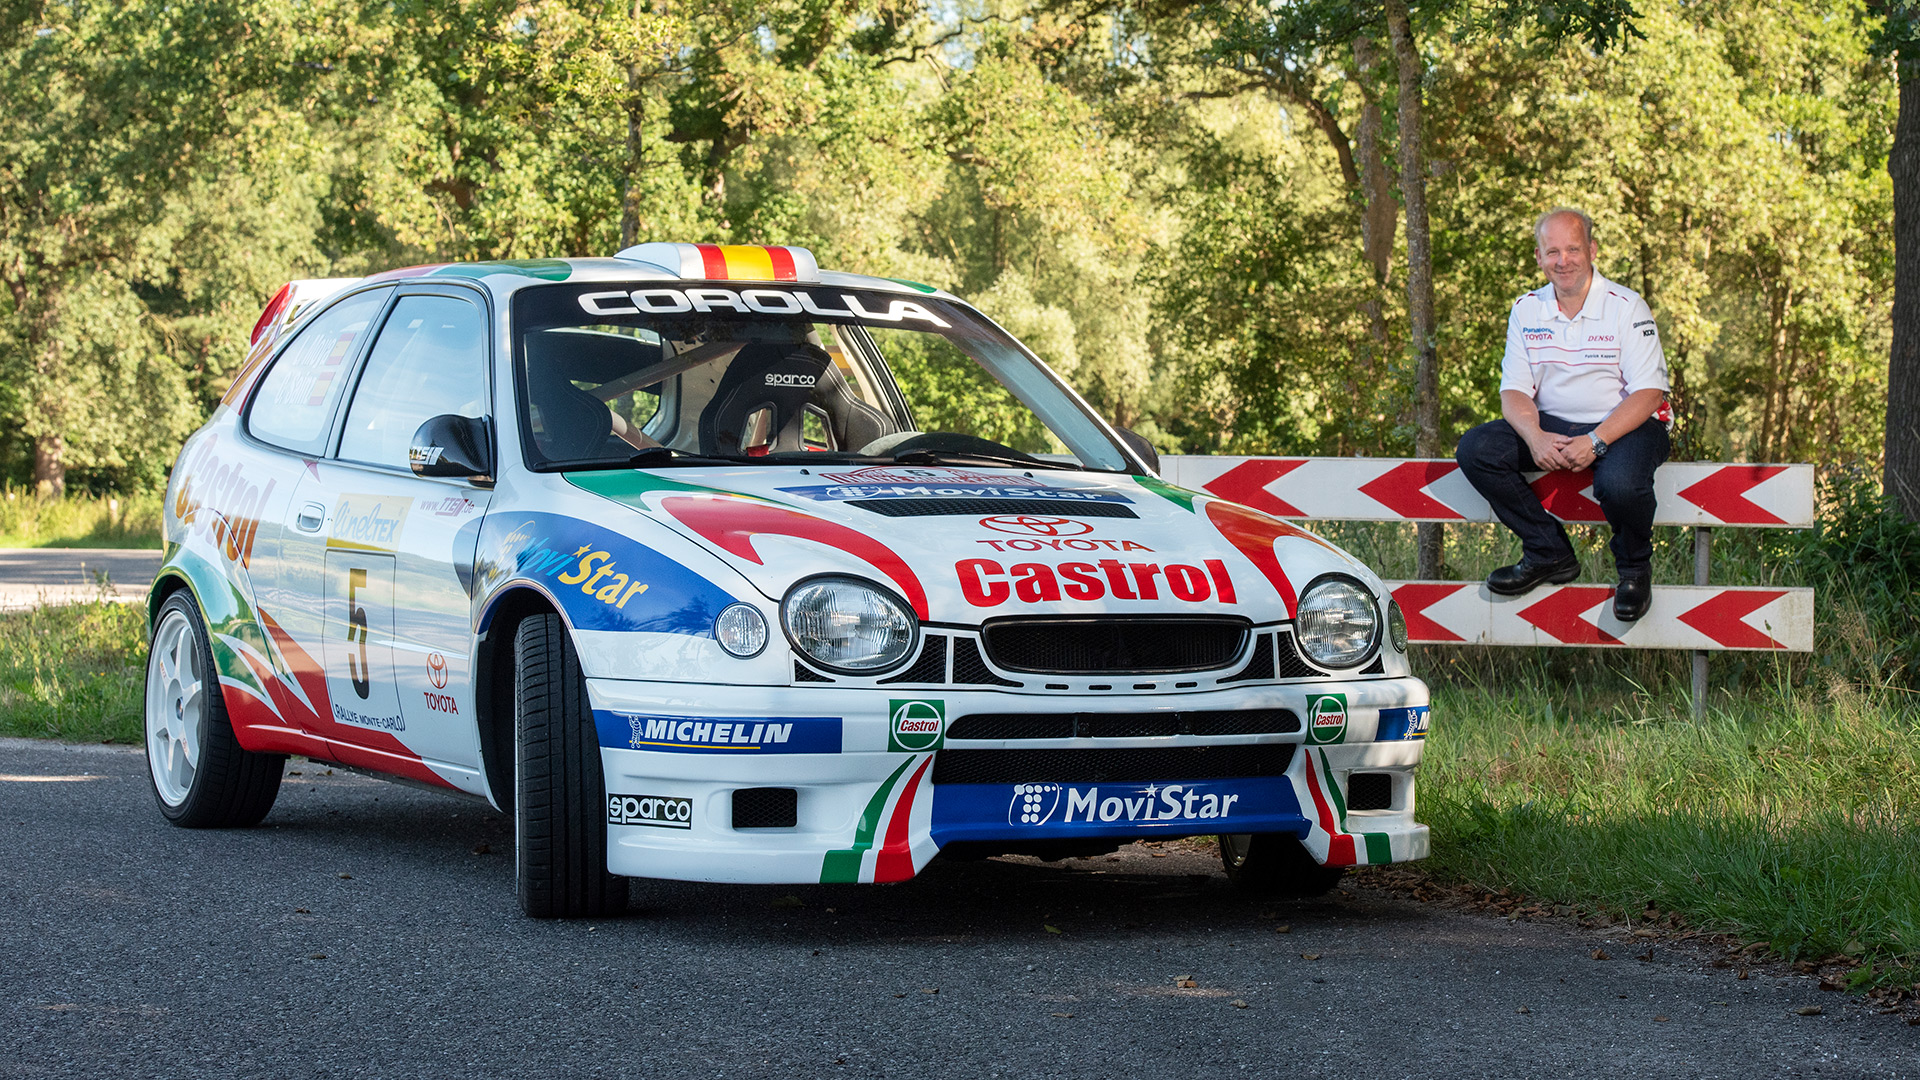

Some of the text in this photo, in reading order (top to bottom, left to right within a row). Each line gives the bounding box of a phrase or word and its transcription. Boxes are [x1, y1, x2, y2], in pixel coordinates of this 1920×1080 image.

[578, 289, 952, 328] COROLLA
[765, 373, 815, 387] sparco
[904, 469, 936, 477] 5
[175, 433, 277, 570] Castrol
[891, 486, 1102, 500] MoviStar
[975, 539, 1156, 552] TOYOTA
[516, 537, 649, 609] MoviStar
[955, 558, 1237, 608] Castrol
[347, 568, 370, 700] 5
[424, 692, 459, 715] TOYOTA
[335, 704, 402, 731] RALLYE MONTE-CARLO
[900, 719, 939, 732] Castrol
[1315, 713, 1344, 726] Castrol
[644, 719, 793, 744] MICHELIN
[609, 796, 692, 827] sparco
[1064, 784, 1239, 823] MoviStar
